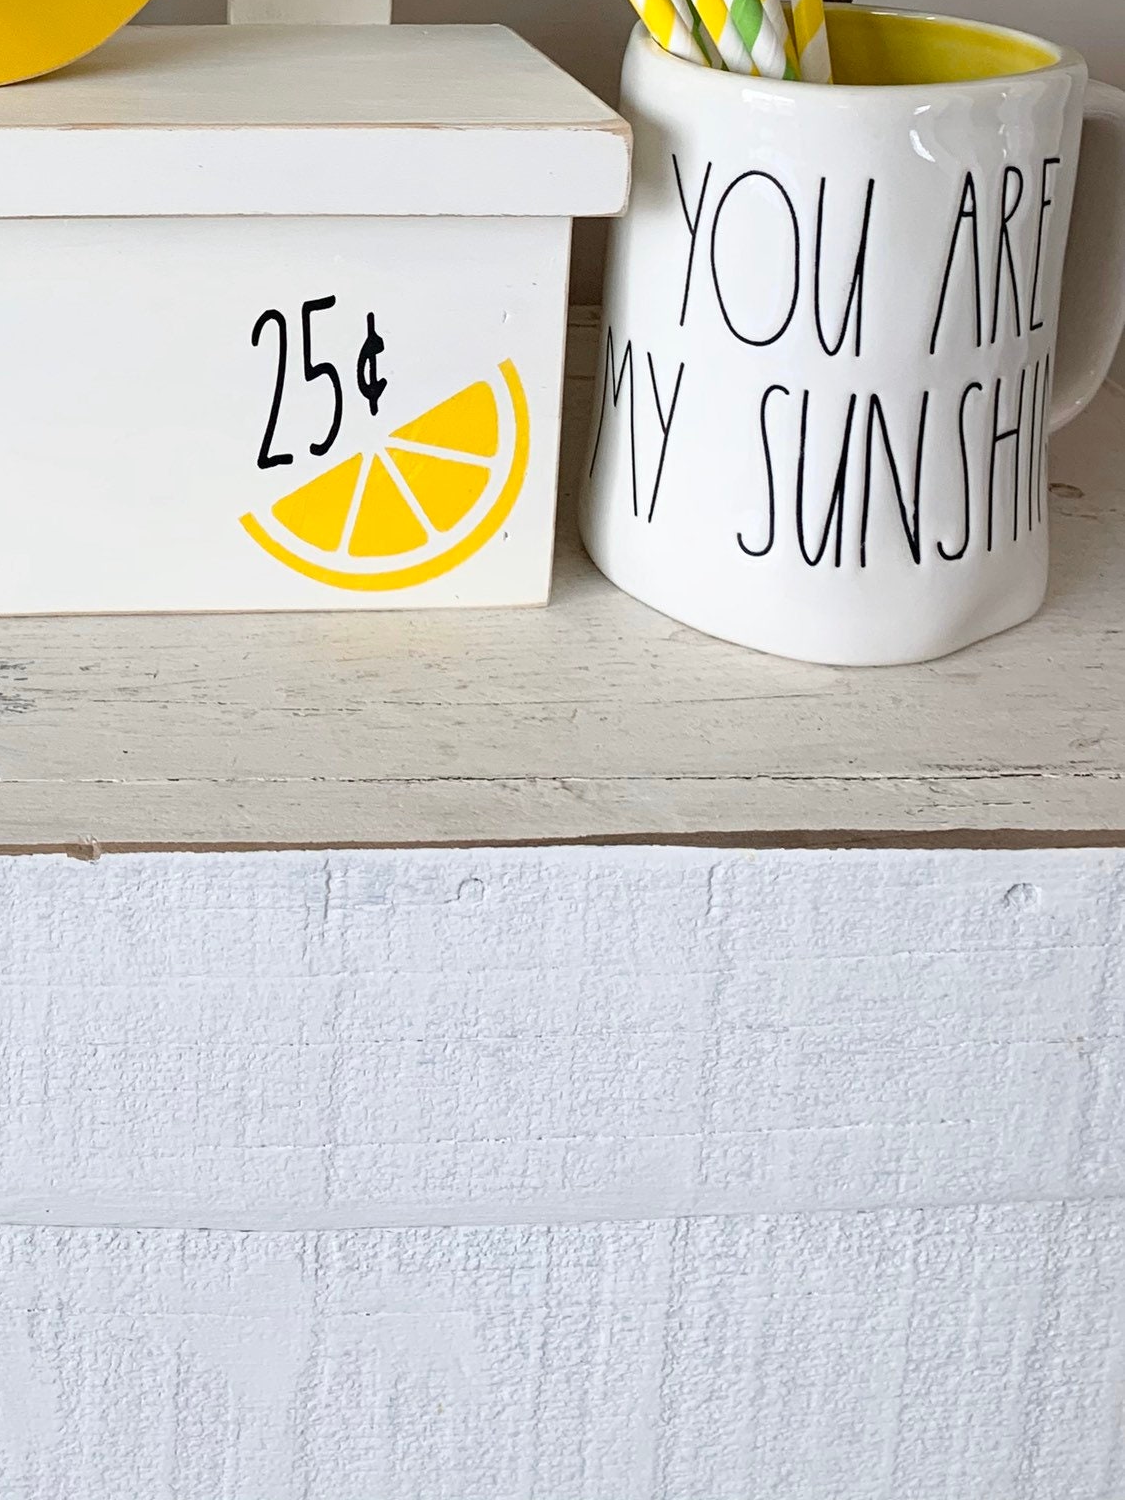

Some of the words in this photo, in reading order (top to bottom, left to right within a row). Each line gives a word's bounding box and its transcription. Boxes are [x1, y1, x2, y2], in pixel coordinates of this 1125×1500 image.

[672, 153, 875, 357] YOU
[930, 158, 1061, 354] ARE
[250, 295, 388, 470] 25¢
[589, 325, 684, 523] MY
